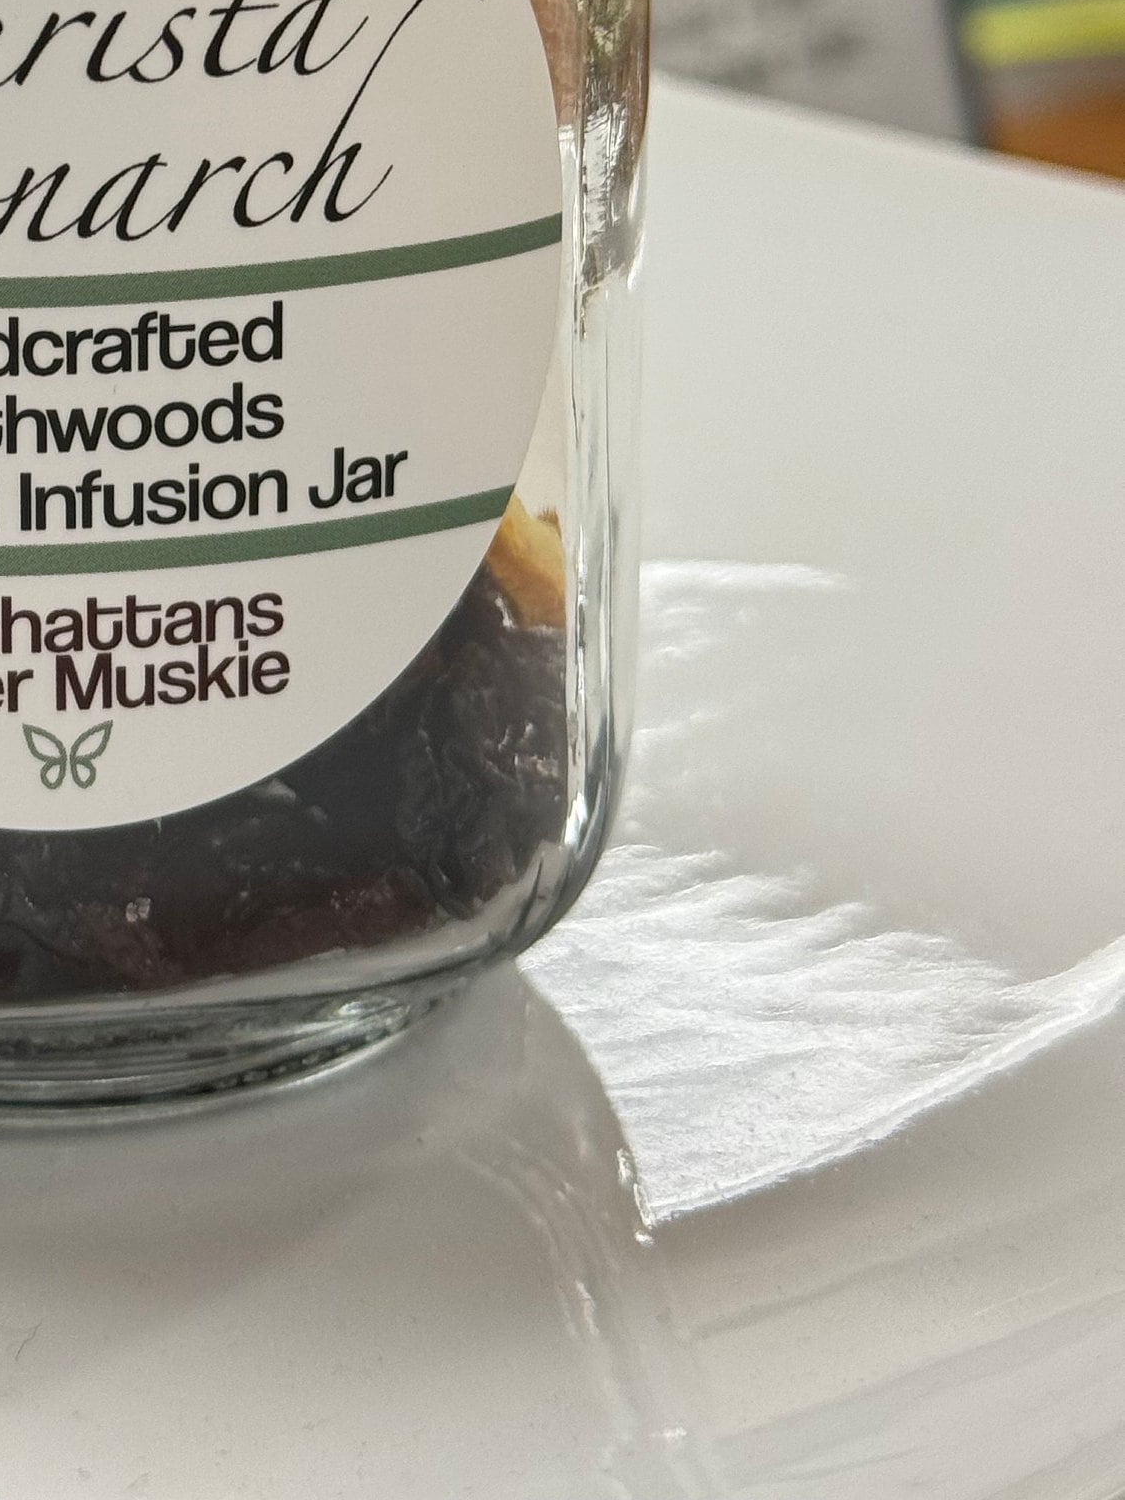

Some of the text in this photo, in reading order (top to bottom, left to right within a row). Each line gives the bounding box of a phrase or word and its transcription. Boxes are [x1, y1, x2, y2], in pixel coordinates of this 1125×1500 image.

[19, 469, 289, 533] Infusion
[308, 446, 410, 510] Jar
[55, 638, 292, 713] Muskie
